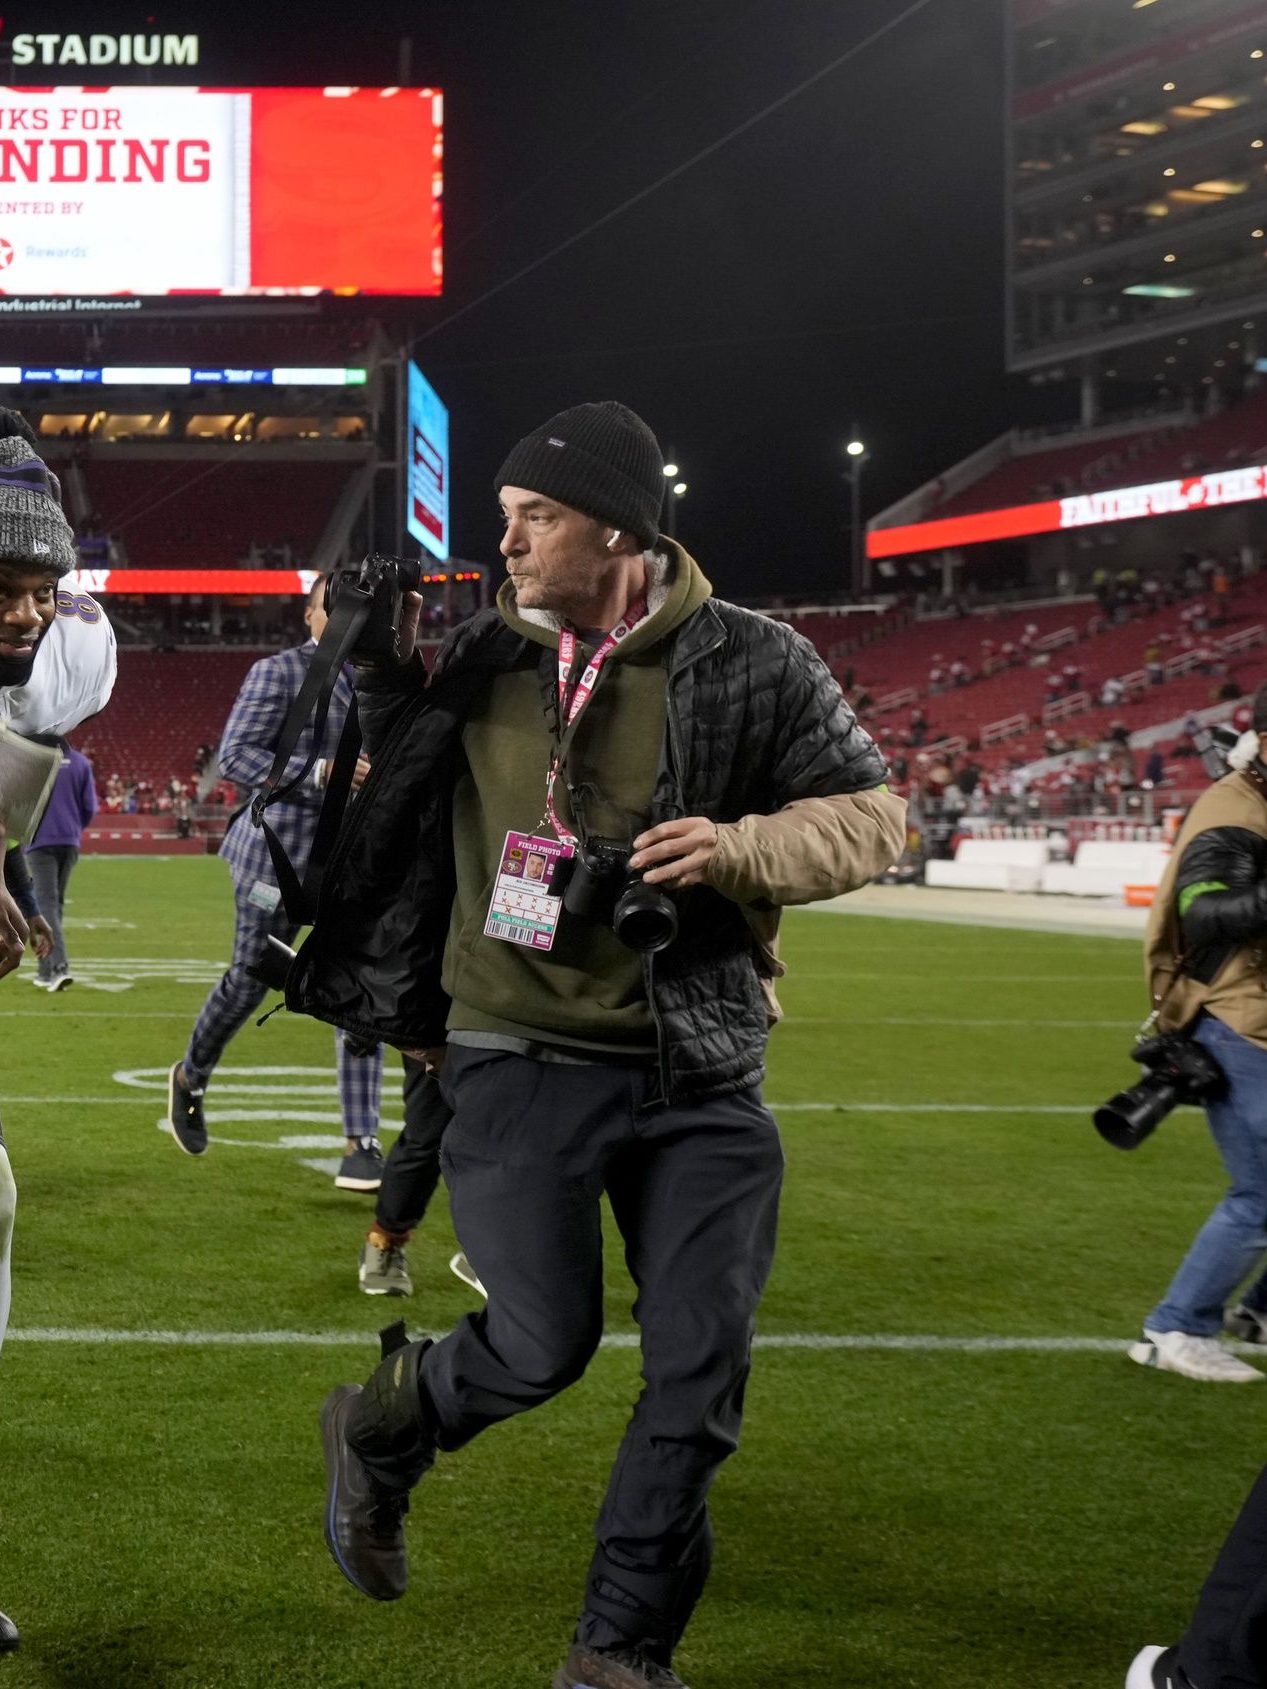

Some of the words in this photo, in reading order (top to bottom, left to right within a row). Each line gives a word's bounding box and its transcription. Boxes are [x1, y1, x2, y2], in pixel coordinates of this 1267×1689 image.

[12, 34, 199, 65] STADIUM
[60, 108, 123, 130] FOR
[61, 202, 84, 215] BY
[26, 246, 87, 258] Rewards
[1059, 480, 1189, 528] FAITHFUL
[538, 845, 561, 856] PHOTO
